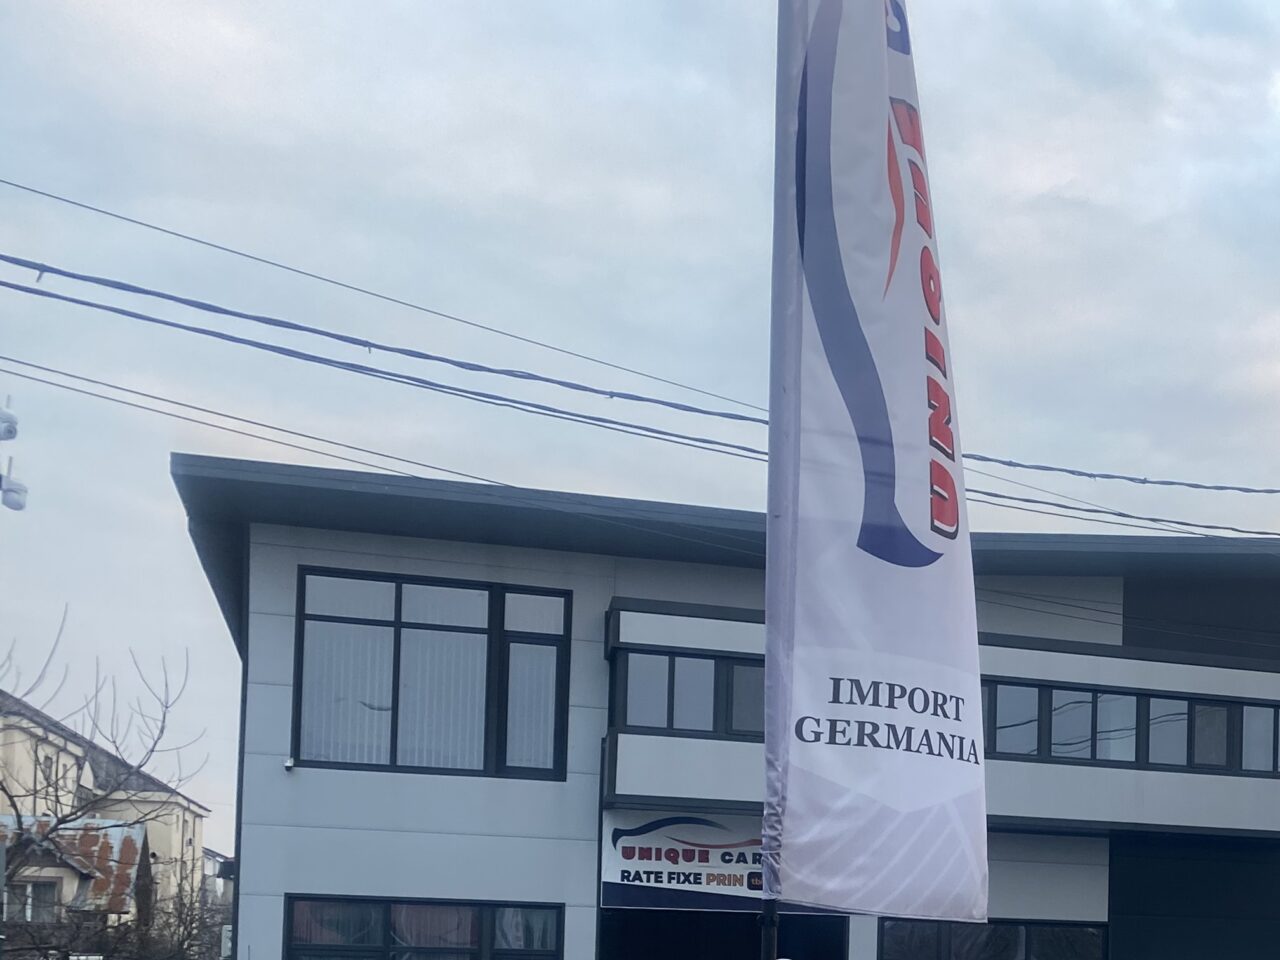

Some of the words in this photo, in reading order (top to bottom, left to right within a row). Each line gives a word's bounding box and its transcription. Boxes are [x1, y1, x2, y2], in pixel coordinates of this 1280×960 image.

[828, 677, 965, 722] IMPORT
[794, 715, 981, 766] GERMANIA
[621, 846, 710, 865] UNIQUE
[720, 851, 763, 865] CAR
[620, 869, 663, 884] RATE
[667, 871, 703, 886] FIXE
[706, 873, 744, 887] PRIN
[752, 877, 763, 886] tb
